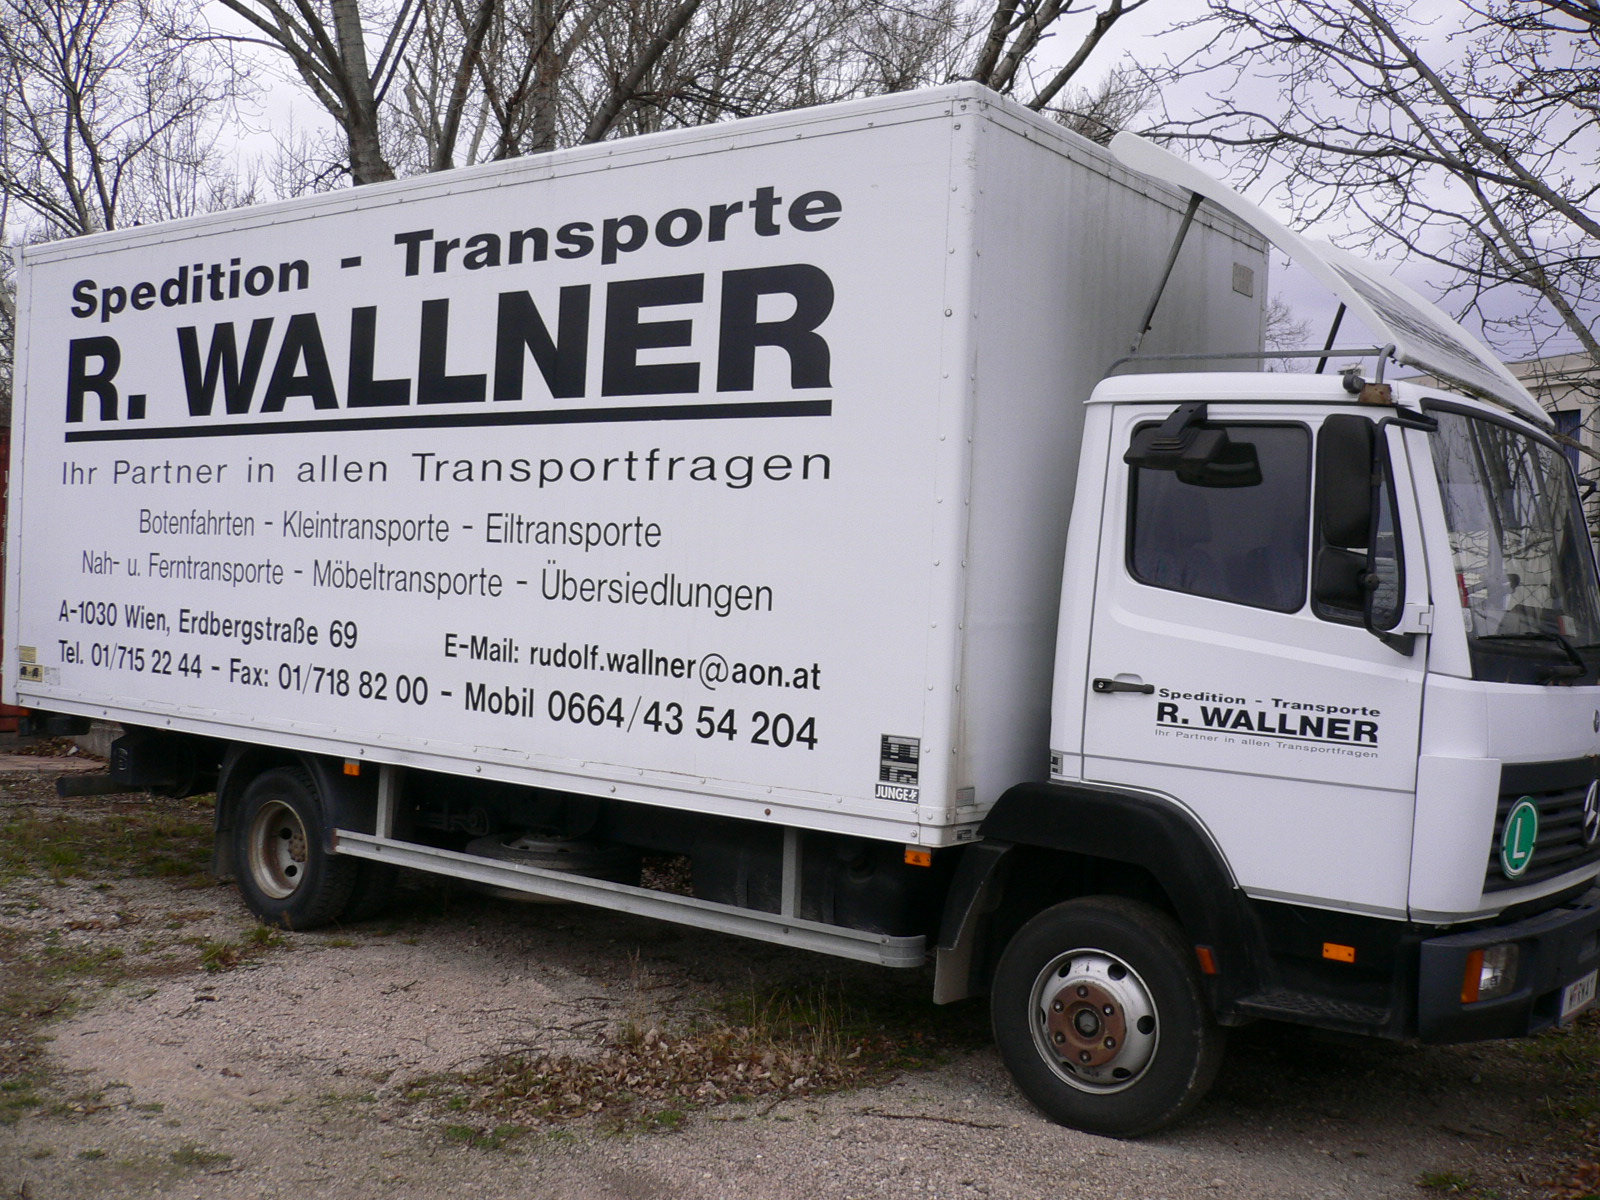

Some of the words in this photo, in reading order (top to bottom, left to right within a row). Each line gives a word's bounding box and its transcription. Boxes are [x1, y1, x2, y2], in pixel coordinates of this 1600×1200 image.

[71, 258, 309, 323] Spedition
[395, 186, 842, 276] Transporte
[66, 336, 147, 423] R.
[177, 264, 834, 416] WALLNER
[62, 460, 98, 485] Ihr
[114, 459, 228, 485] Partner
[247, 456, 274, 483] in
[298, 454, 387, 483] allen
[412, 448, 831, 490] Transportfragen
[139, 508, 255, 537] Botenfahrten
[284, 510, 450, 547] Kleintransporte
[487, 512, 662, 553] Eiltransporte
[82, 550, 120, 576] Nah-
[127, 558, 141, 578] u.
[149, 552, 284, 588] Ferntransporte
[313, 559, 503, 600] Möbeltransporte
[541, 559, 773, 618] Übersiedlungen
[59, 599, 118, 627] A-1030
[125, 603, 171, 637] Wien,
[179, 608, 319, 646] Erdbergstraße
[329, 619, 358, 650] 69
[444, 632, 519, 664] E-Mail:
[530, 642, 821, 691] rudolf.wallner@aon.at
[58, 640, 84, 666] Tel.
[91, 642, 145, 673] 01/715
[152, 649, 172, 676] 22
[178, 652, 203, 679] 44
[230, 657, 269, 688] Fax:
[278, 662, 350, 697] 01/718
[359, 670, 388, 701] 82
[395, 674, 429, 706] 00
[465, 681, 534, 718] Mobil
[547, 690, 684, 736] 0664/43
[695, 705, 738, 741] 54
[750, 710, 818, 751] 204
[1158, 687, 1246, 705] Spedition
[1271, 697, 1381, 718] Transporte
[1155, 728, 1171, 737] Ihr
[1175, 730, 1219, 742] Partner
[1224, 735, 1235, 744] in
[1241, 736, 1270, 748] allen
[1276, 740, 1379, 759] Transportfragen
[1156, 701, 1190, 725] R.
[1200, 705, 1379, 744] WALLNER
[875, 785, 909, 801] JUNGE
[1512, 816, 1526, 860] L
